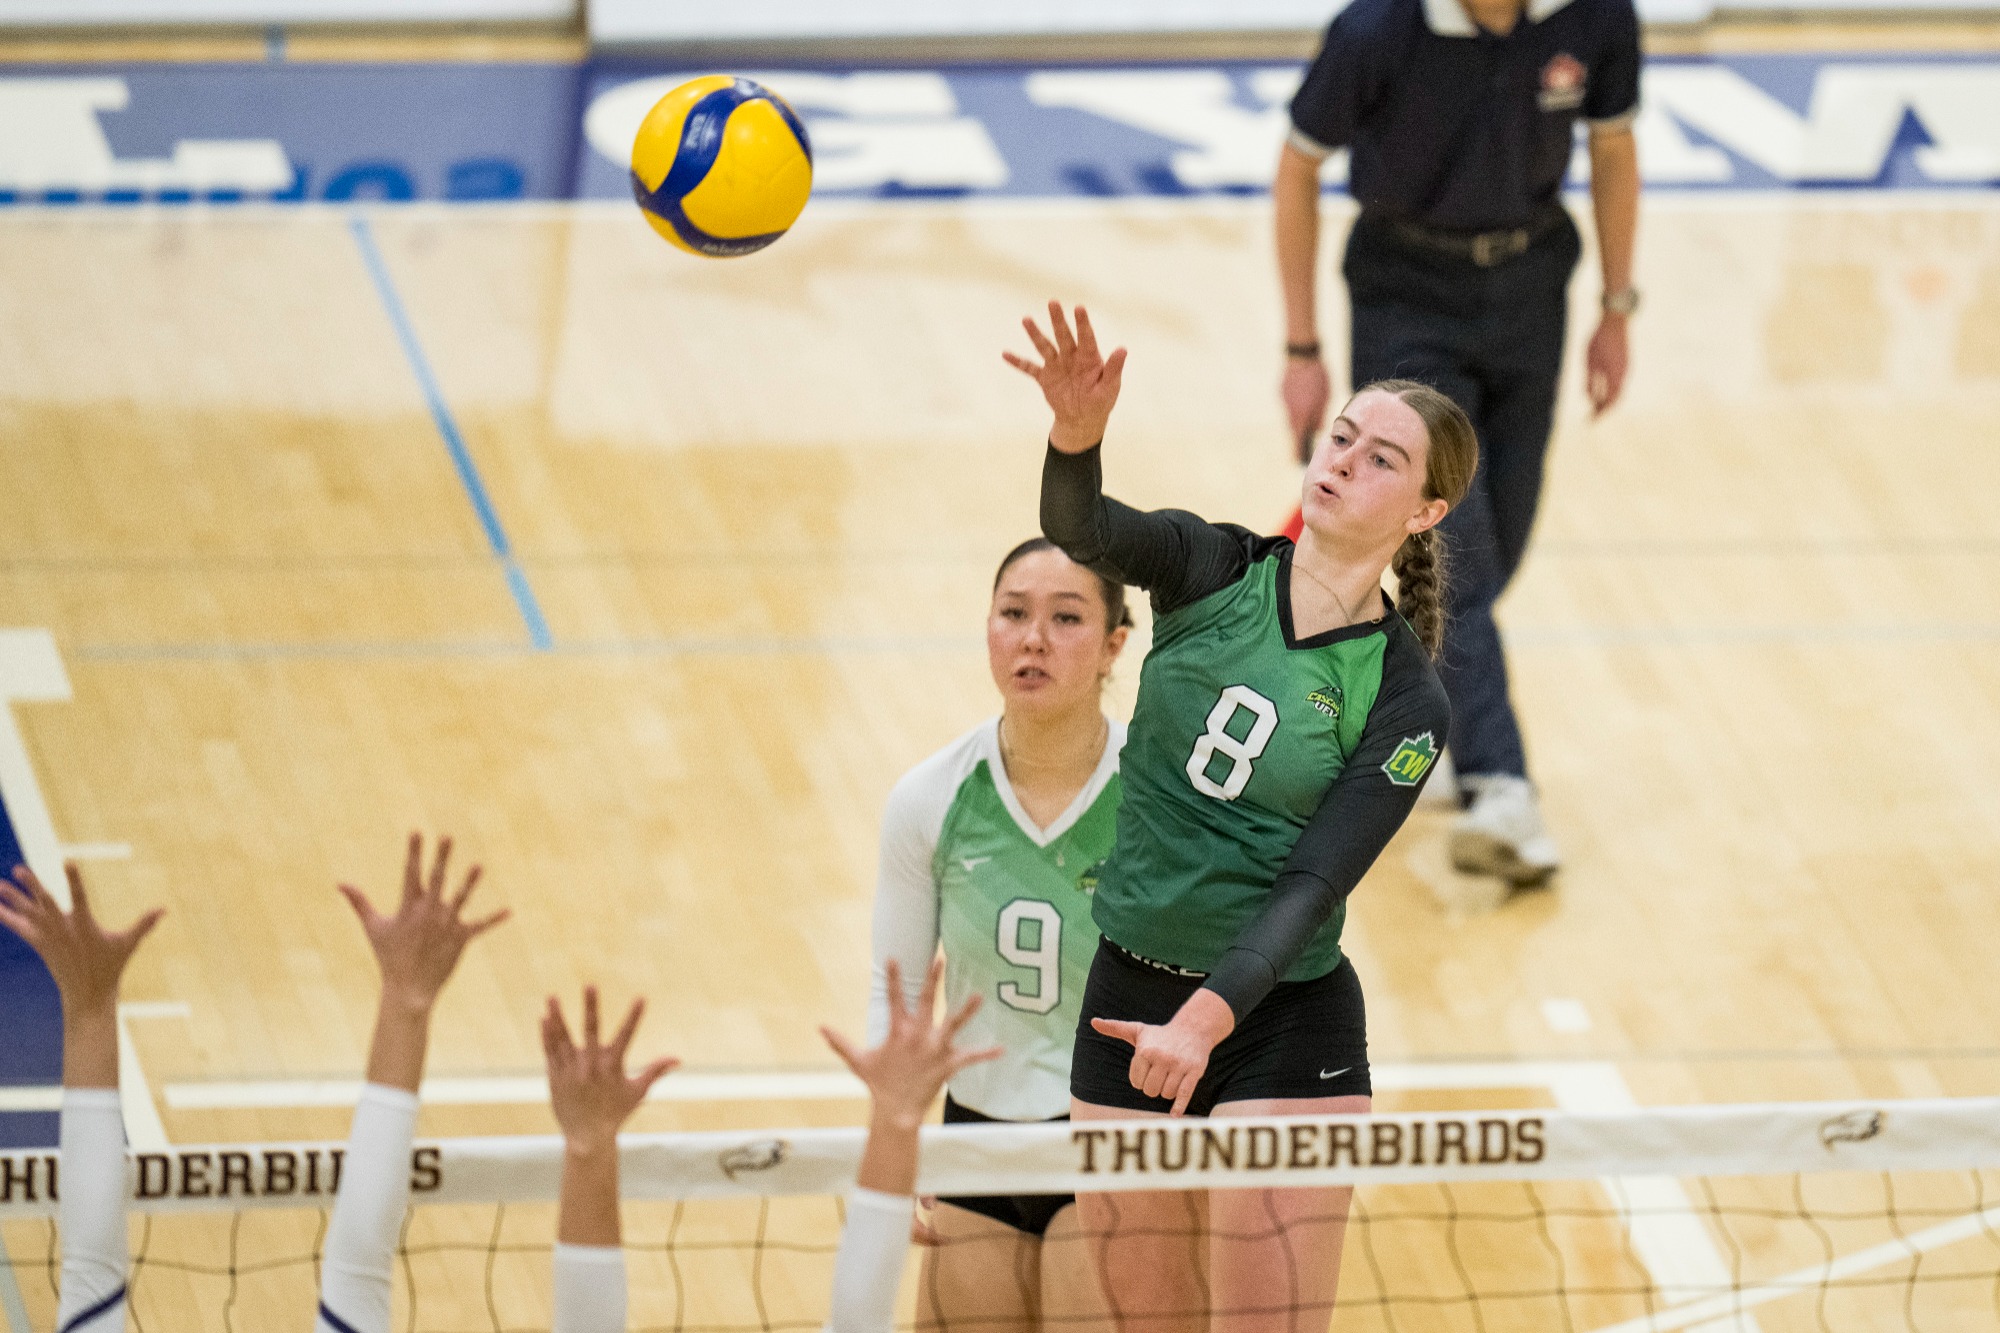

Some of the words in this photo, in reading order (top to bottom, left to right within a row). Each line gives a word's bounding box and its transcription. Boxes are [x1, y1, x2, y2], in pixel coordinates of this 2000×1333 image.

[1184, 683, 1280, 801] 8
[1389, 749, 1430, 780] CW
[996, 897, 1063, 1015] 9
[1073, 1117, 1546, 1174] THUNDERBIRDS
[0, 1148, 442, 1203] HDERBIS
